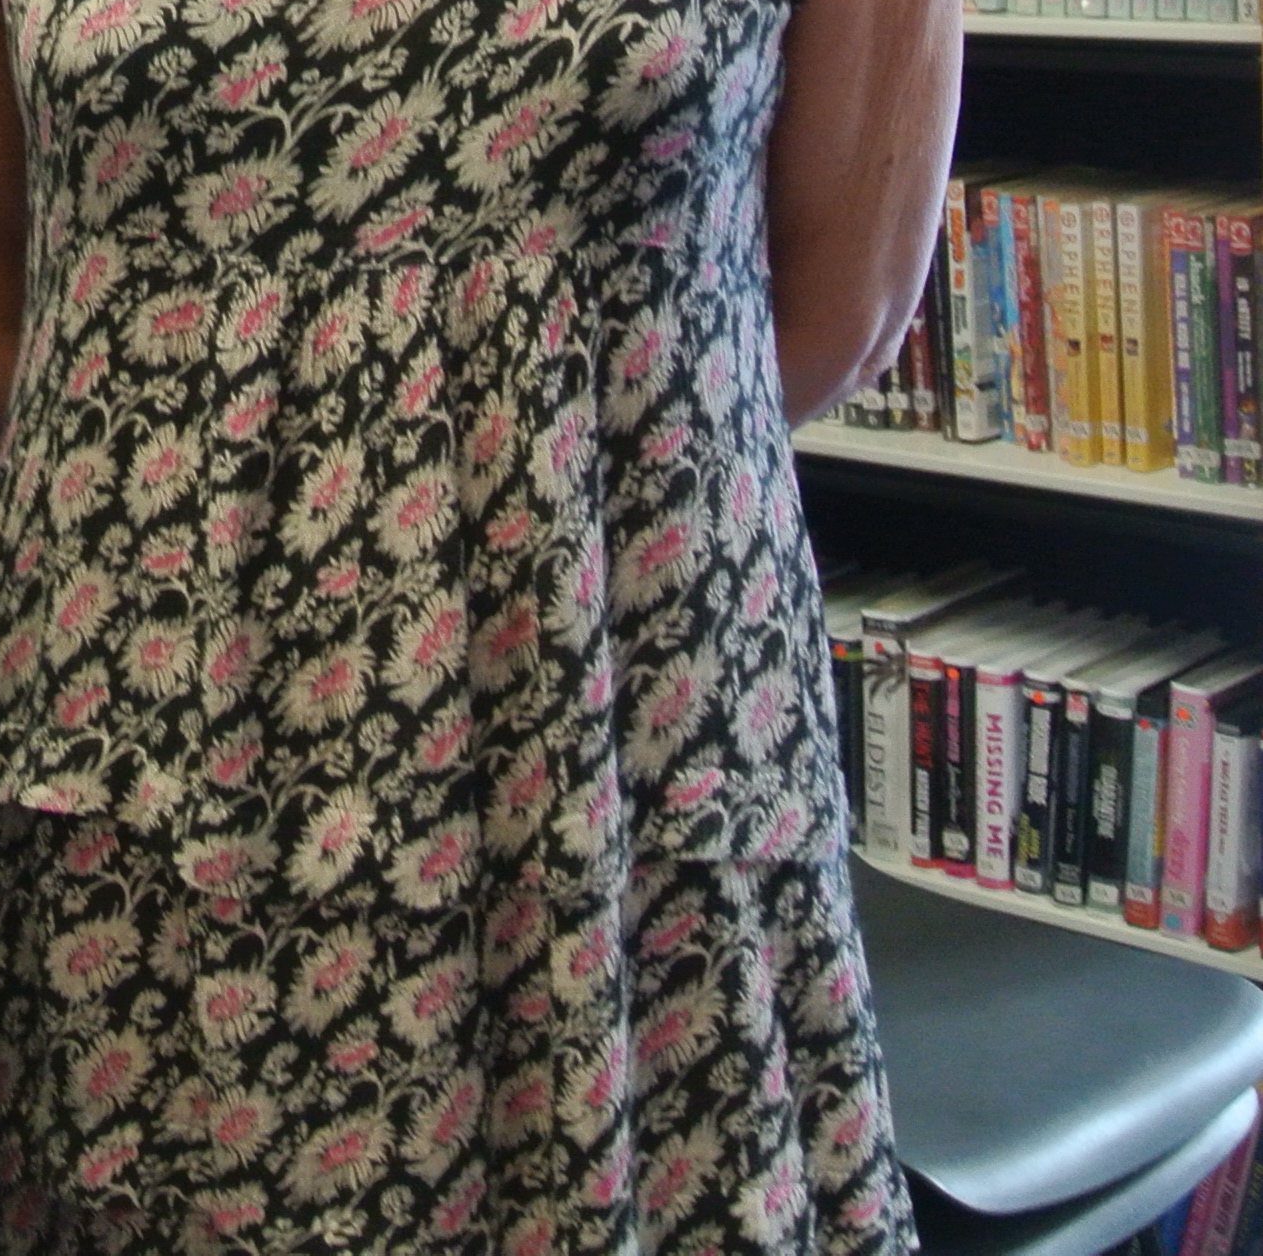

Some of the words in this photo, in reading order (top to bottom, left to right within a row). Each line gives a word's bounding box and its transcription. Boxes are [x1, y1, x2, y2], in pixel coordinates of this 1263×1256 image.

[911, 681, 932, 716] THE
[867, 710, 886, 809] ELDEST
[913, 720, 934, 769] HUNT
[986, 711, 1005, 815] MISSING
[986, 824, 1005, 862] ME
